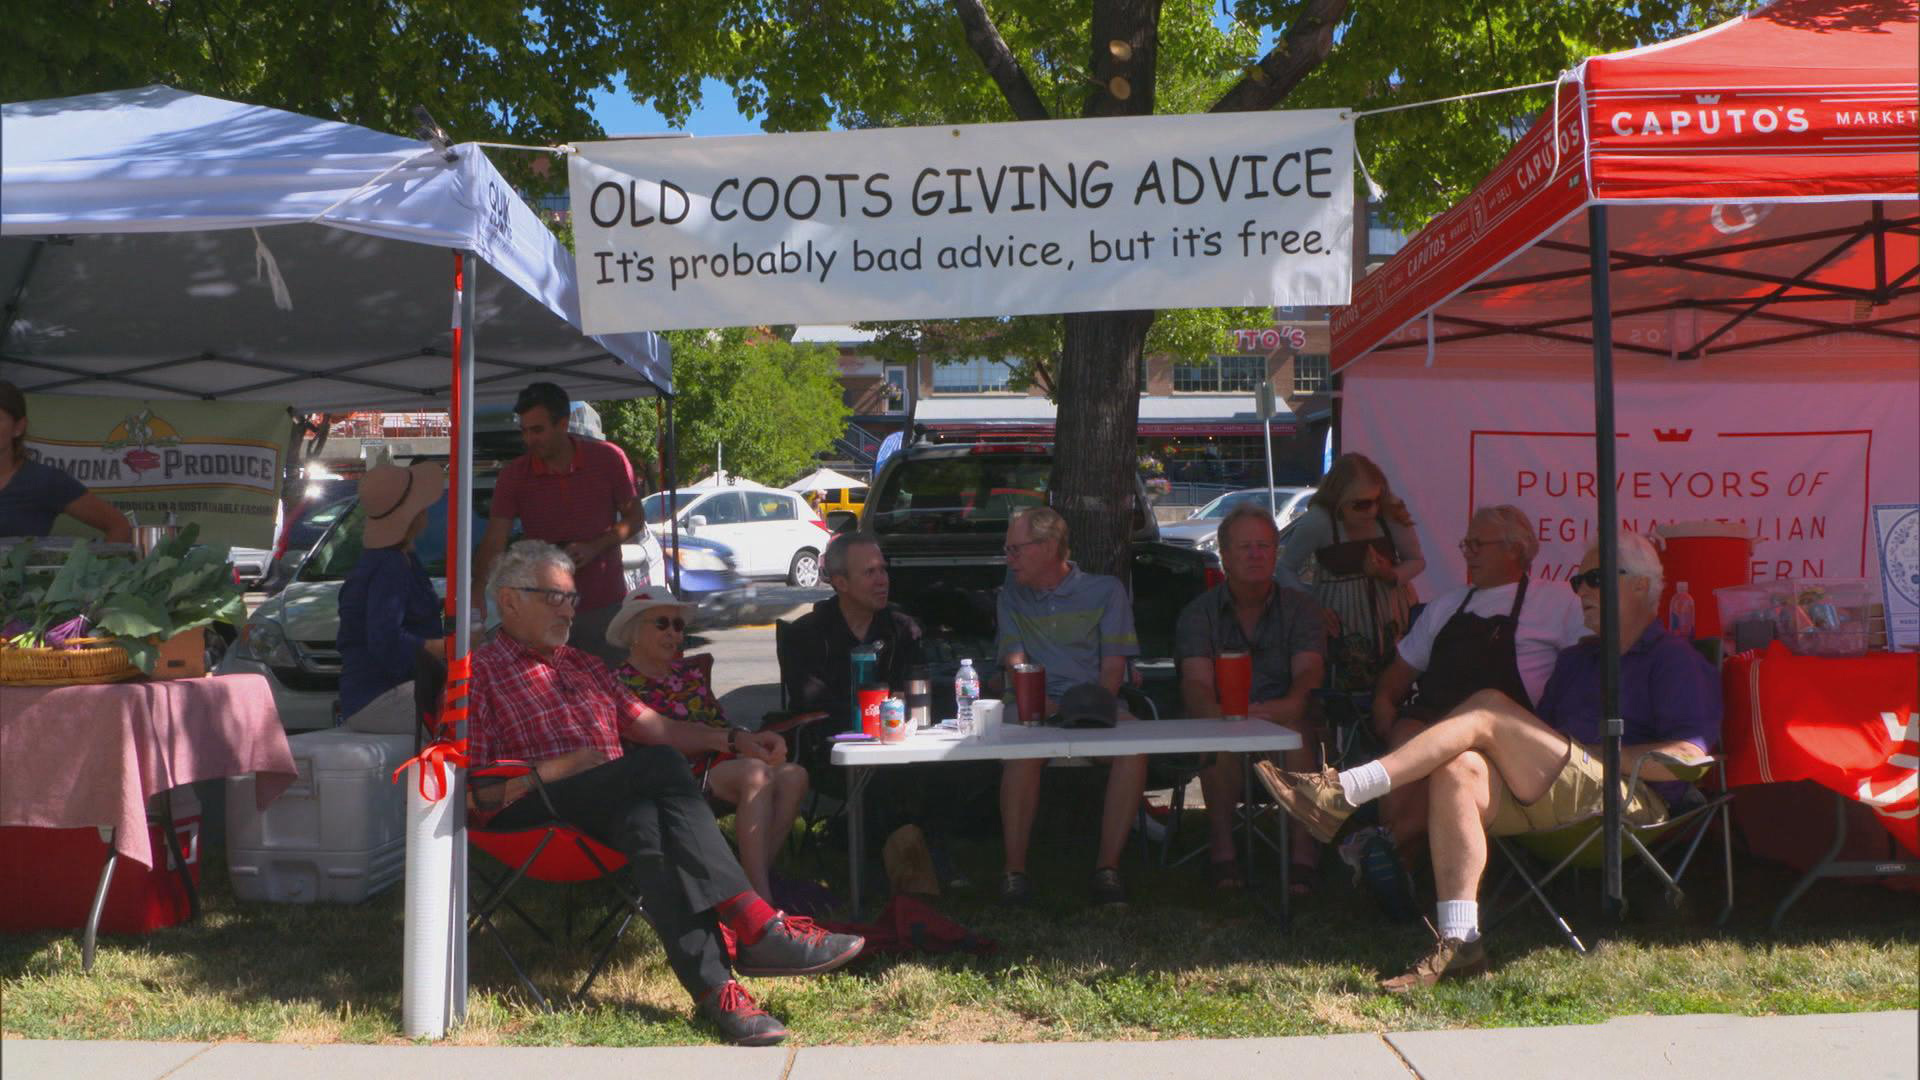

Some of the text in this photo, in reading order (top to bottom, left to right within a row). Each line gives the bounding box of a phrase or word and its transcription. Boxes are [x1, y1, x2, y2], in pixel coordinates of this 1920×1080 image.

[1611, 106, 1918, 136] CAPUTO'S MARKET
[1516, 120, 1580, 191] CAPUO'S
[590, 147, 1333, 229] OLD COOTS GIVING ADVICE
[594, 219, 1332, 291] It's probably bad advice, but it's free.
[164, 449, 273, 481] PRODUCE
[1787, 472, 1830, 497] OF
